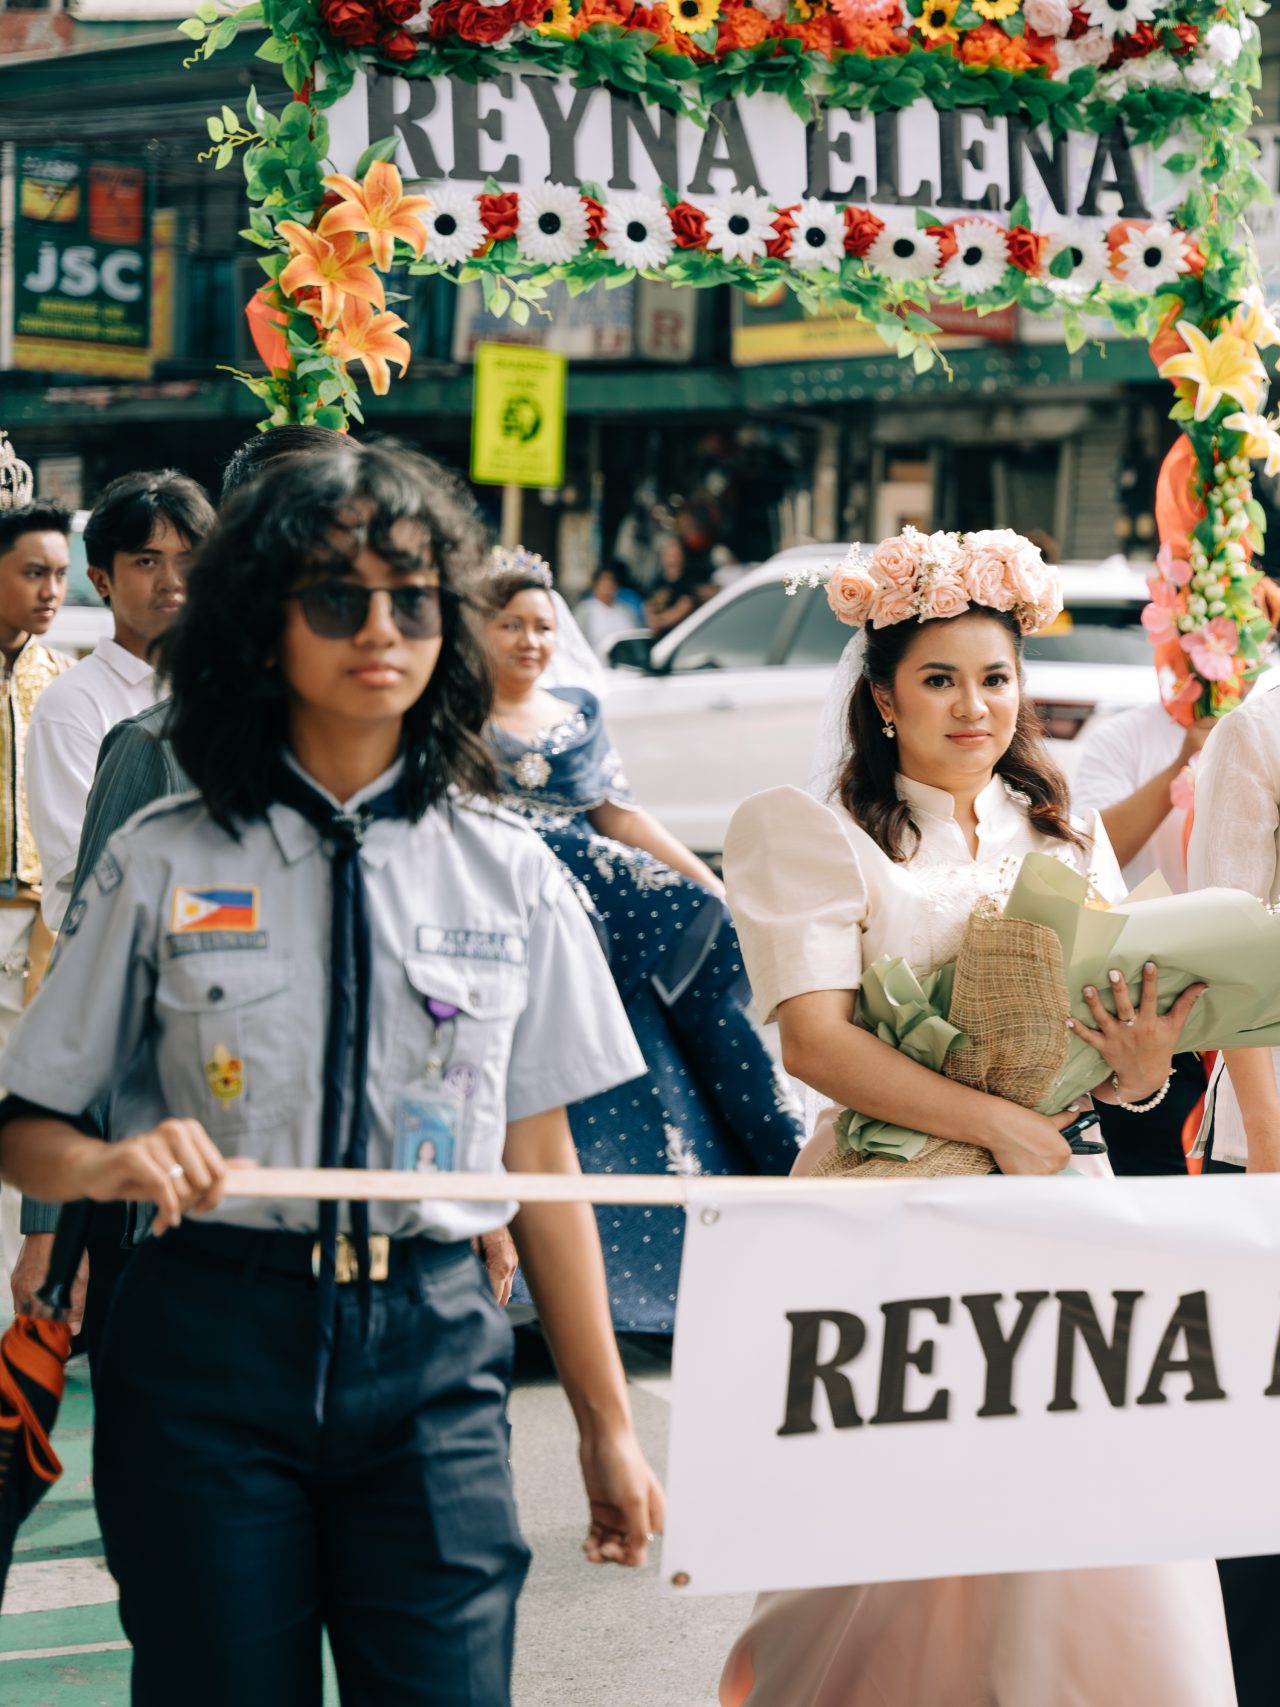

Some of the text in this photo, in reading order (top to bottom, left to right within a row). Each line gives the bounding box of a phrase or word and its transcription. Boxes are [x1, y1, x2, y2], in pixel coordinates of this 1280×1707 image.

[365, 63, 1154, 219] REYNA ELENA
[23, 241, 143, 302] JSC
[776, 1288, 1227, 1438] REYNA
